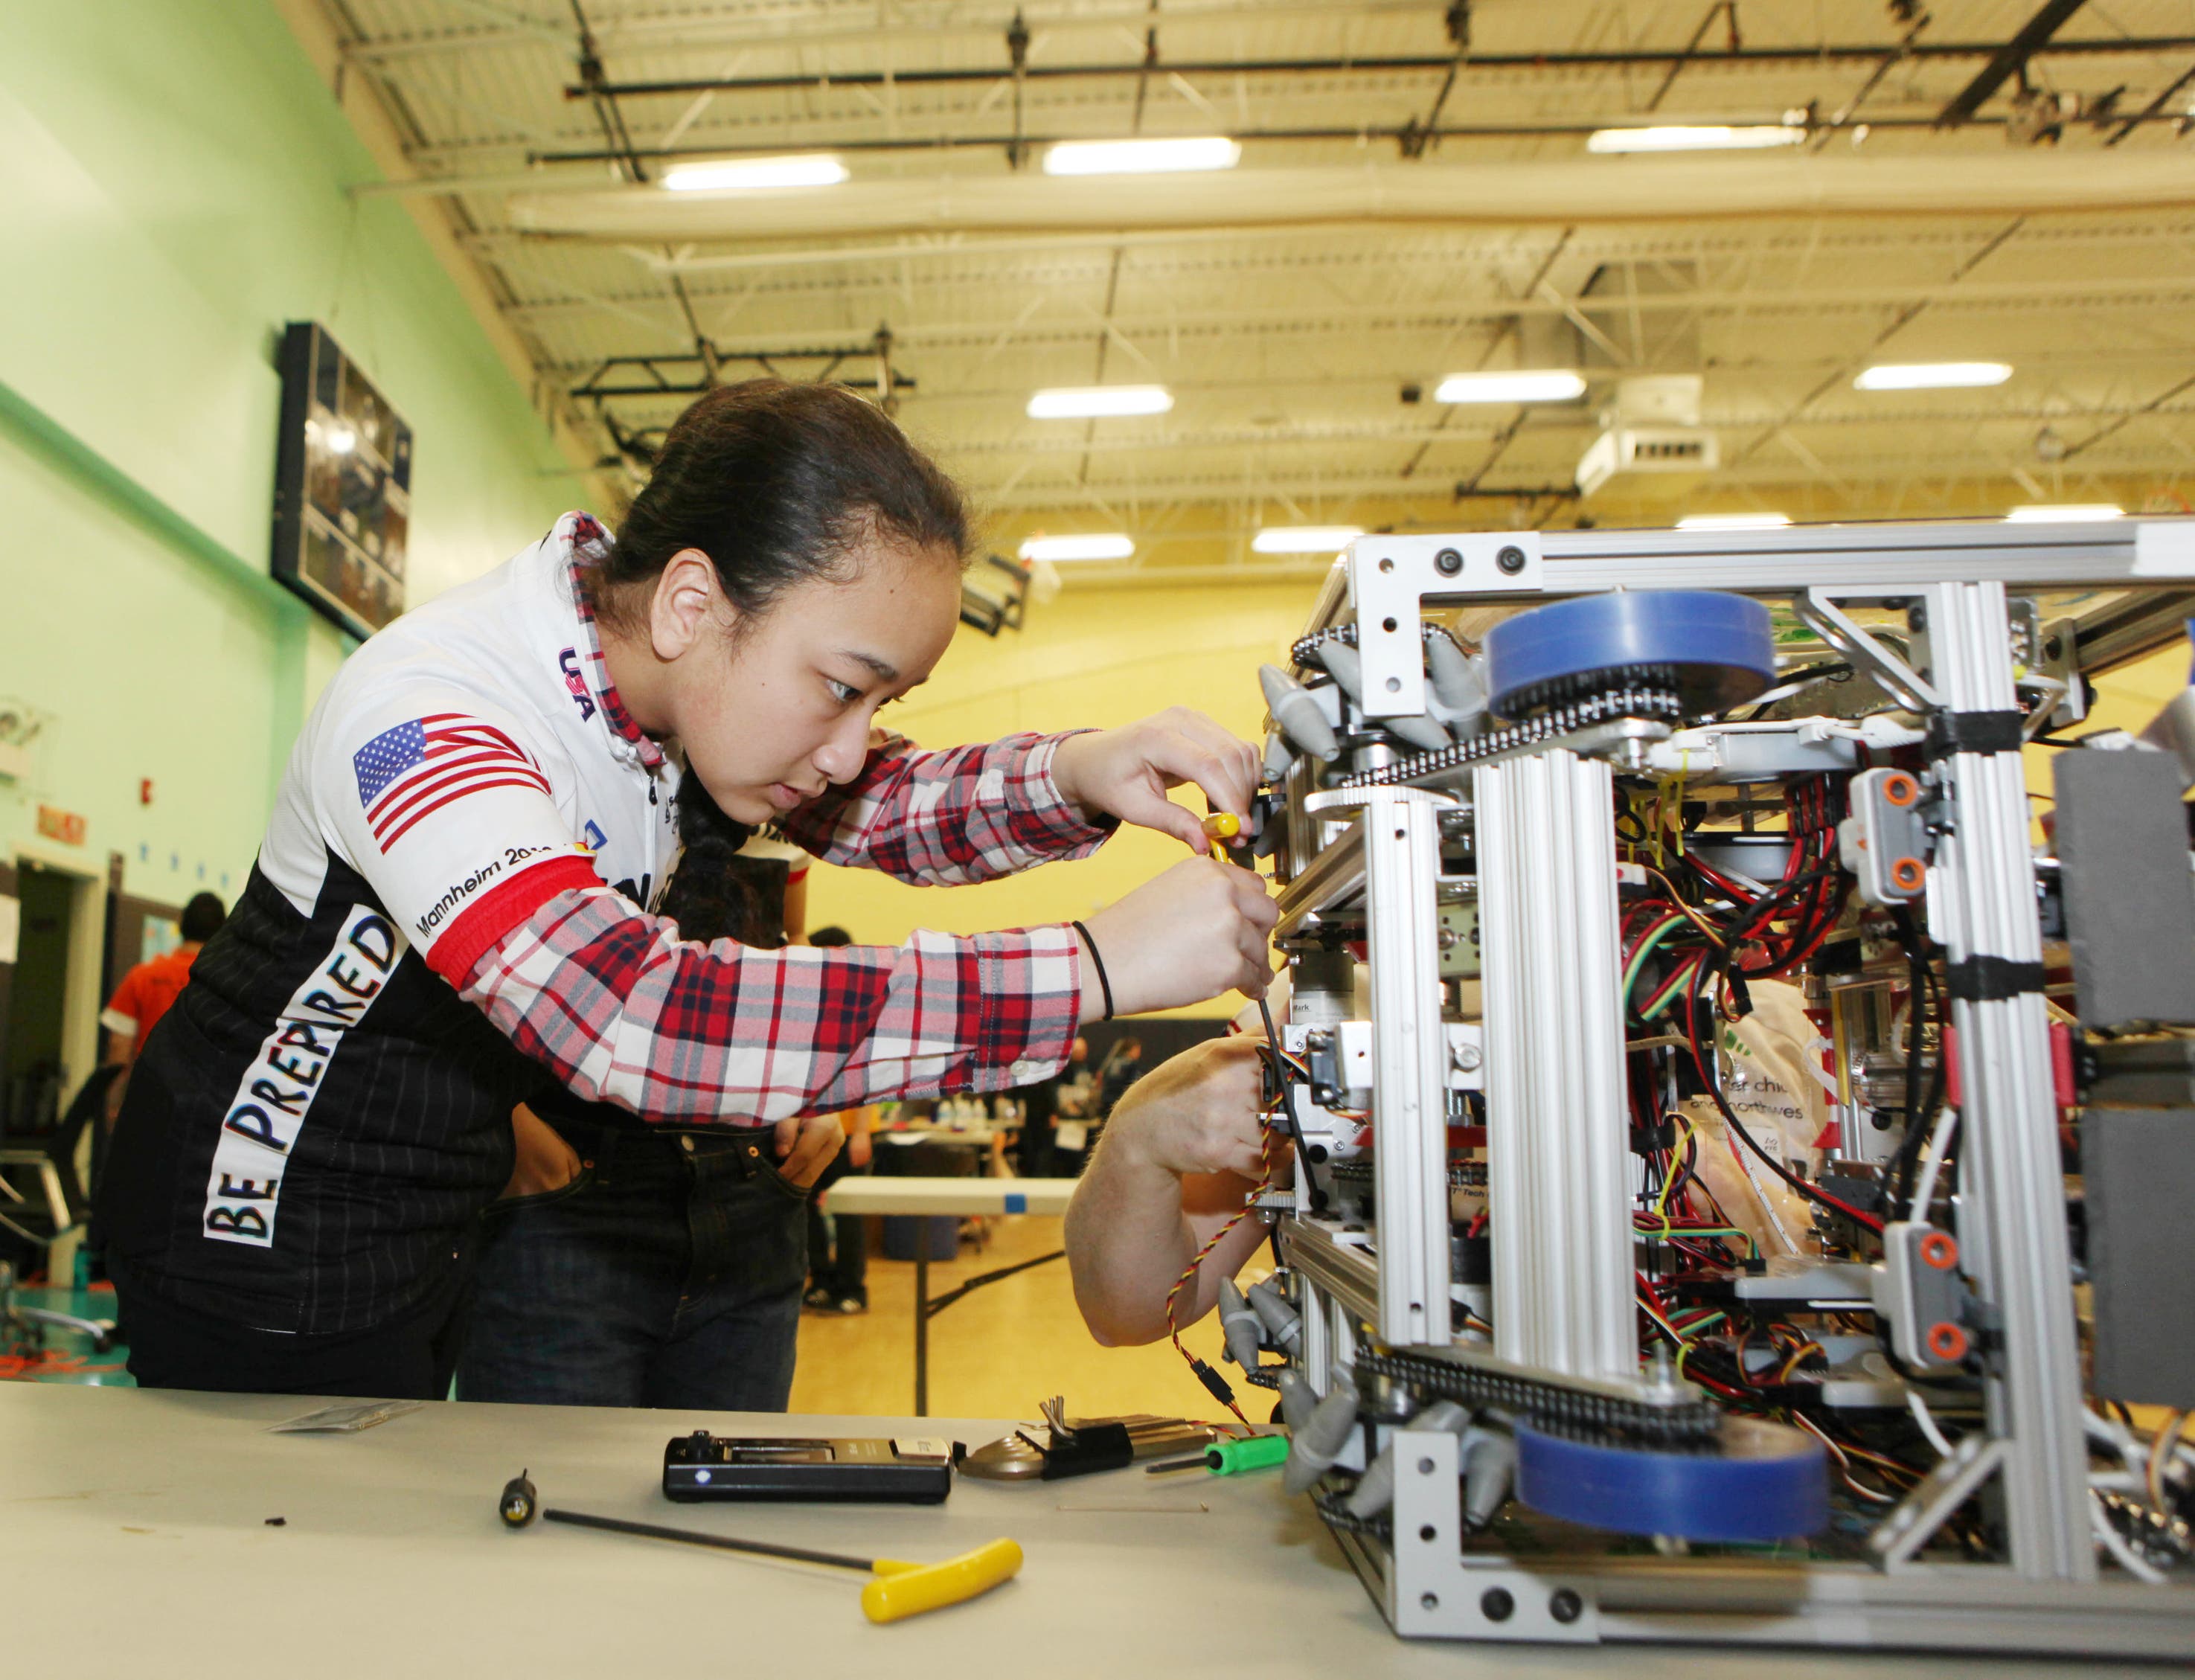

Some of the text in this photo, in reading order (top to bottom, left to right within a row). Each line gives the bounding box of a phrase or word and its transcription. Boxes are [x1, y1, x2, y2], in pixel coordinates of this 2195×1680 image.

[559, 645, 596, 722] USA
[416, 861, 502, 937] Mannheim
[207, 915, 397, 1240] BE PREPRED
